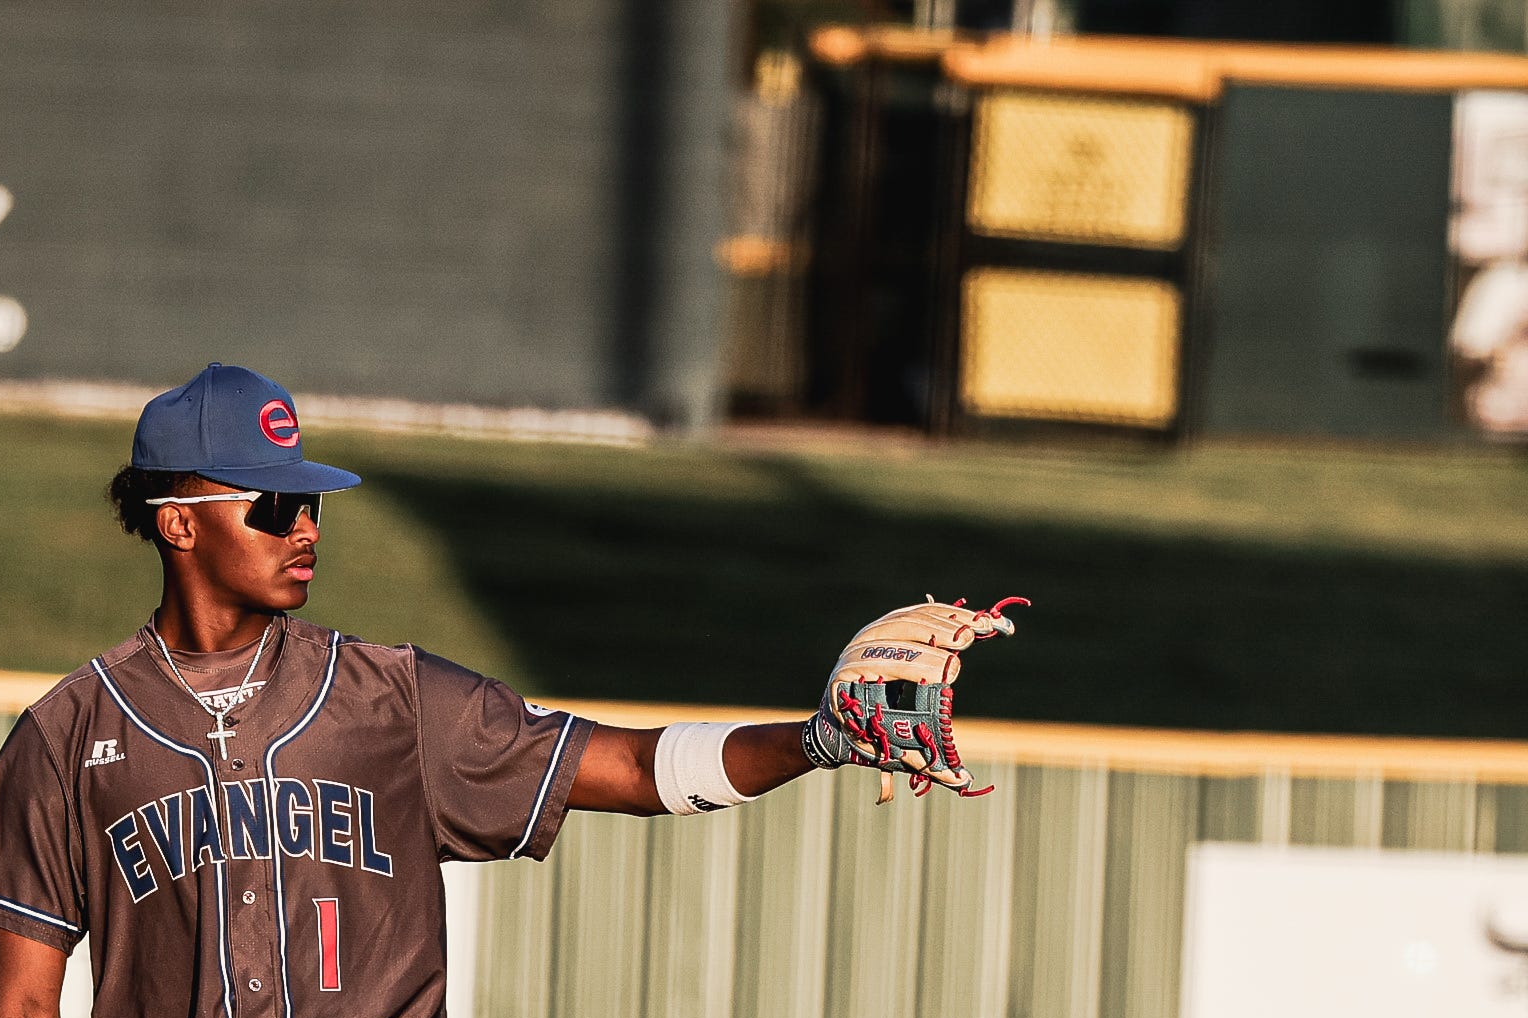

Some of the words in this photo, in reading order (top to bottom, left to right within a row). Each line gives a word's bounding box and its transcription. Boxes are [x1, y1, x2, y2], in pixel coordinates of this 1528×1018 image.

[861, 647, 923, 662] A2000
[84, 752, 126, 768] RUSSELL
[105, 777, 394, 903] EVANGEL
[312, 897, 342, 991] 1
